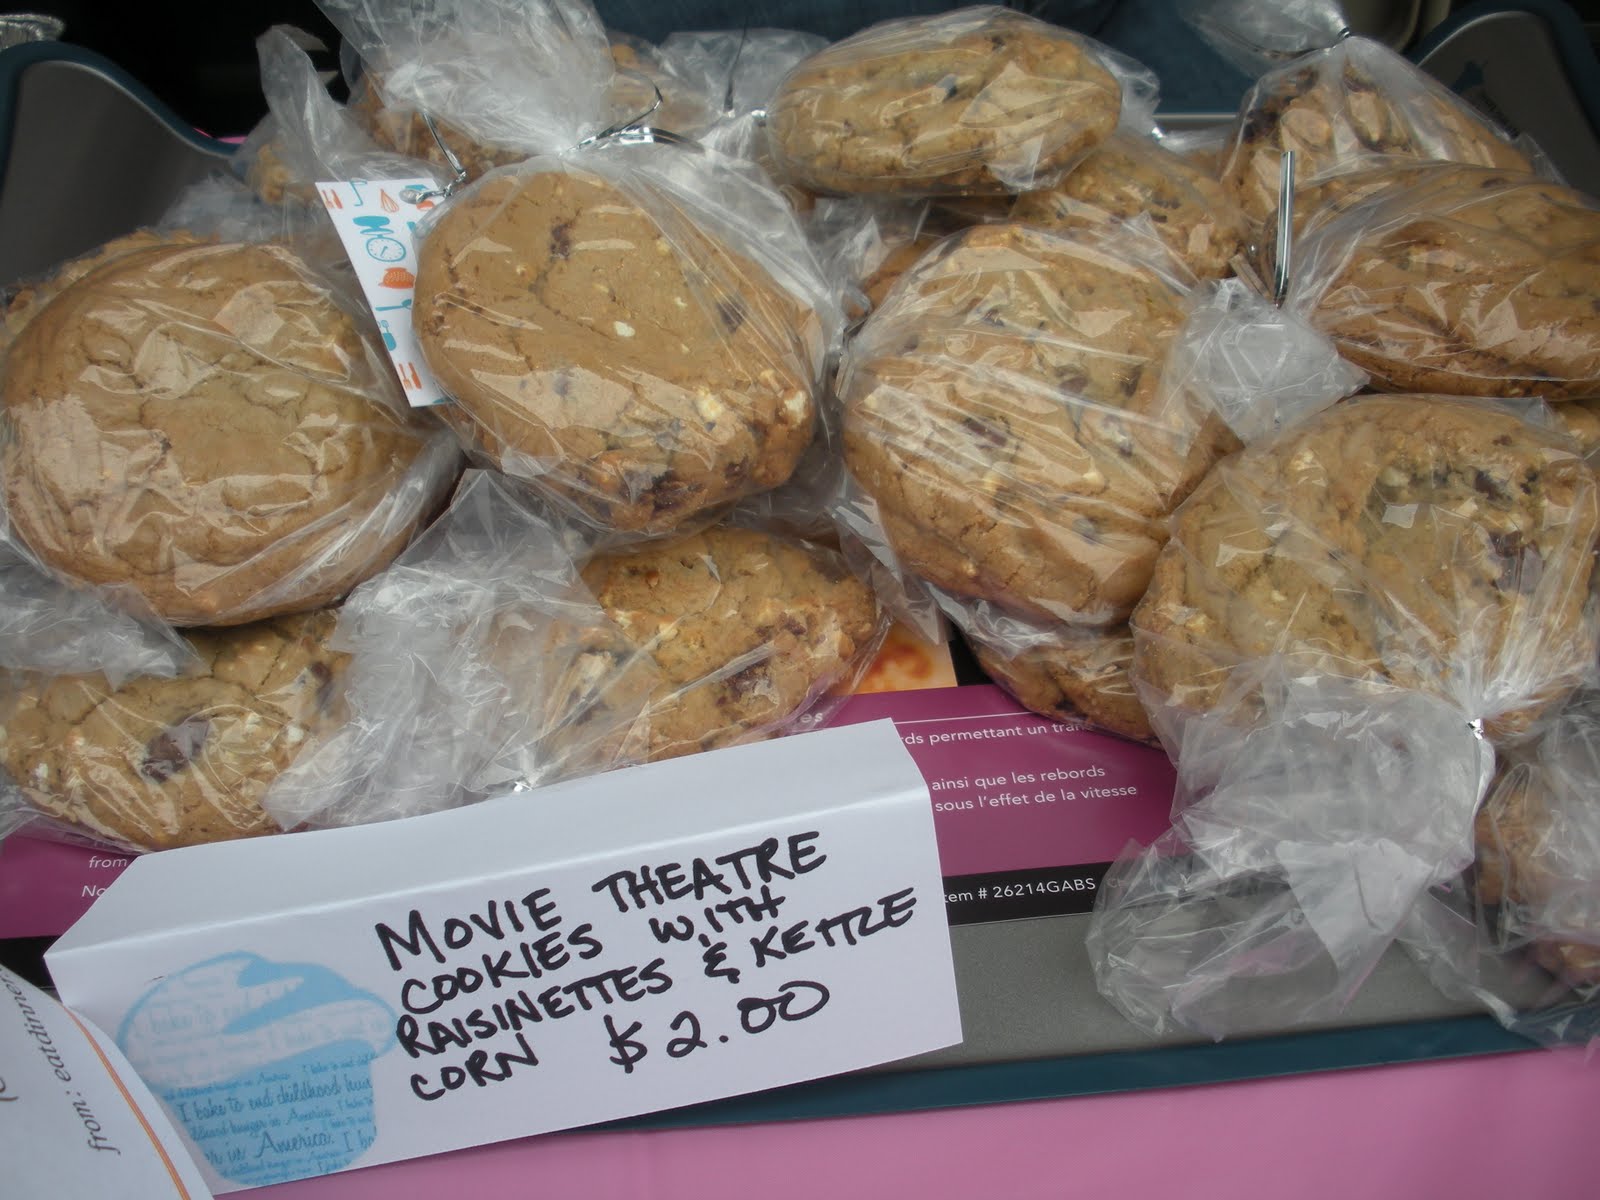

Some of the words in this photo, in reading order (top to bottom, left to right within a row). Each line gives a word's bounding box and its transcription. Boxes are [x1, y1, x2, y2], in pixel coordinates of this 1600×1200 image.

[929, 728, 1023, 746] permettant
[1026, 724, 1047, 736] un
[932, 776, 970, 791] ainsi
[974, 776, 1007, 790] que
[1011, 771, 1036, 784] les
[1040, 765, 1106, 781] rebords
[935, 798, 974, 812] sous
[978, 792, 1030, 808] l'effet
[1034, 790, 1056, 803] de
[1061, 788, 1076, 801] la
[1080, 785, 1138, 800] vitesse
[89, 855, 128, 869] from
[375, 888, 562, 971] MOVIE
[591, 831, 827, 912] THEATRE
[977, 887, 988, 900] #
[992, 877, 1096, 898] 26214GABS
[402, 924, 603, 1014] COOKIES
[649, 885, 786, 943] WITH
[396, 958, 673, 1058] RAISINETTES
[410, 1032, 539, 1101] CORN
